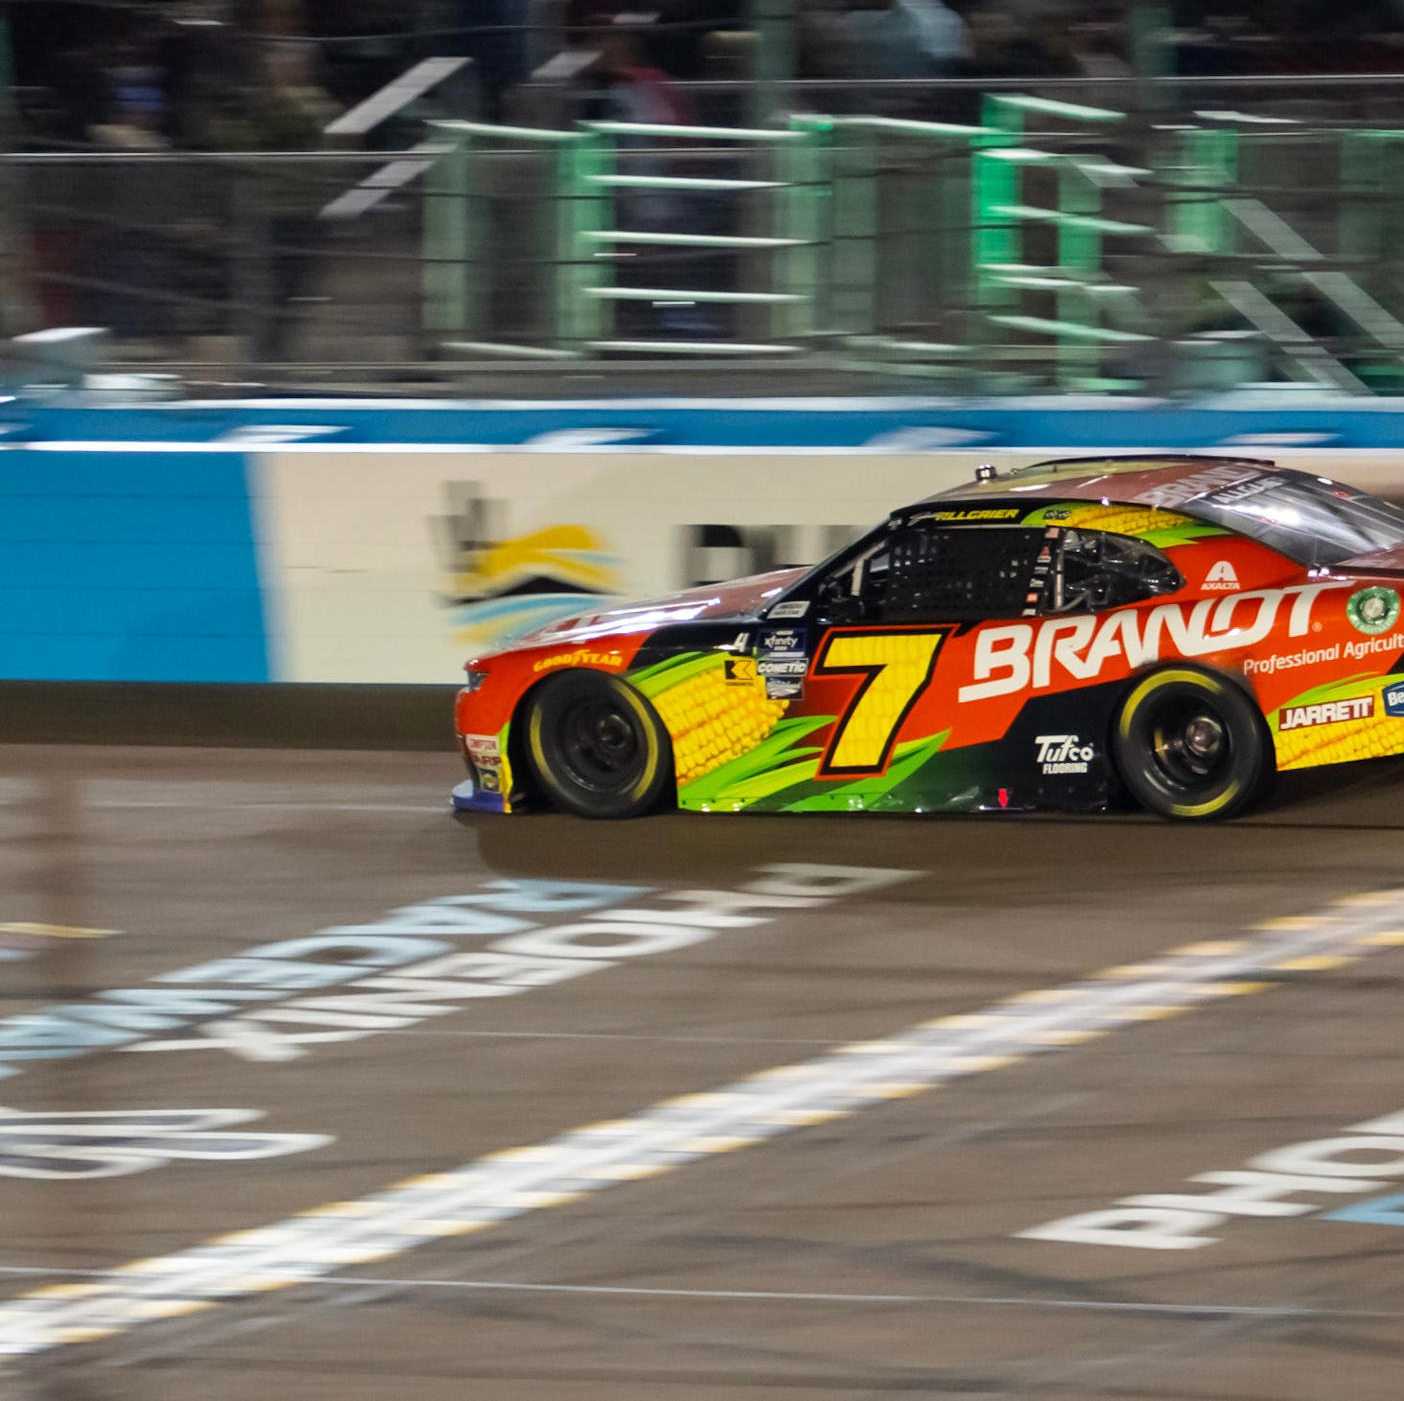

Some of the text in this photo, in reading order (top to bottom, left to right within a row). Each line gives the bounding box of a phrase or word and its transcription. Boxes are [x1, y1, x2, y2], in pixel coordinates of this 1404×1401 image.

[1201, 582, 1241, 591] AXALTA
[764, 635, 799, 649] xfinity
[959, 580, 1355, 703] BRANDT
[1243, 643, 1340, 676] Professional
[818, 629, 947, 776] 7
[1280, 696, 1373, 730] JARRETT
[1034, 734, 1094, 763] Tufco
